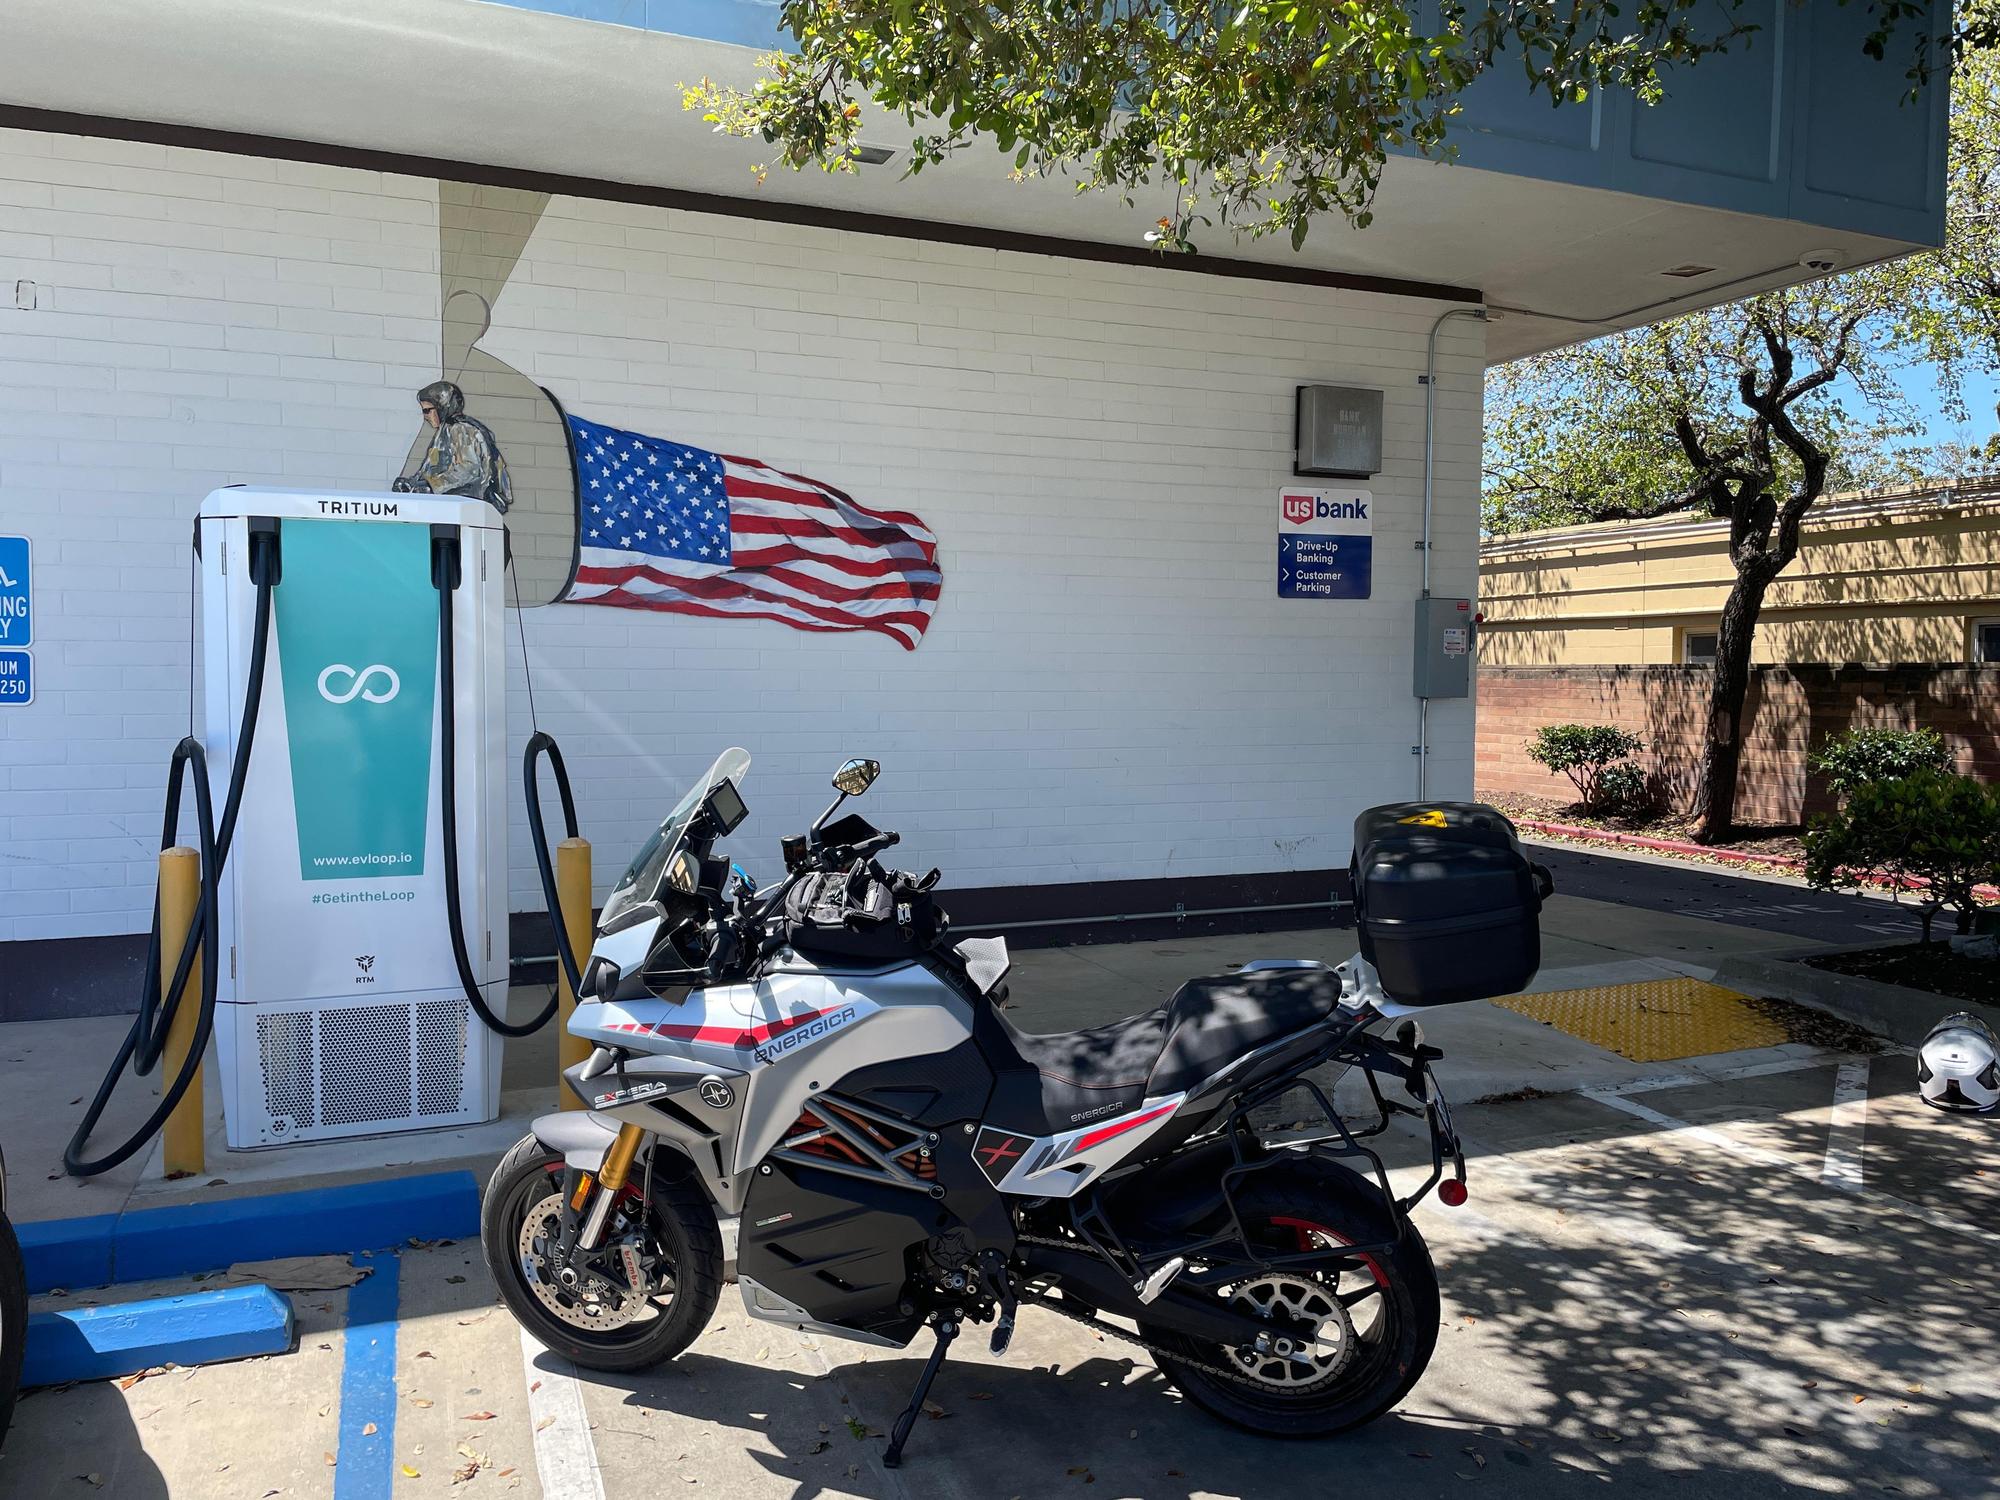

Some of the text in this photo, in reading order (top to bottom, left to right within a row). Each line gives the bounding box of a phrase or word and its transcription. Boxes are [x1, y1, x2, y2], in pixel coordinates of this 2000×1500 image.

[318, 500, 398, 516] TRITIUM
[1316, 496, 1368, 519] bank
[1296, 540, 1338, 553] Drive-Up
[1296, 552, 1334, 565] Banking
[1296, 569, 1342, 581] Customer
[1296, 582, 1331, 594] Parking
[0, 660, 18, 675] UM
[0, 679, 26, 694] 250
[313, 851, 412, 866] www.evloop.io
[312, 891, 415, 904] #GetintheLoop
[624, 1250, 638, 1286] brembo
